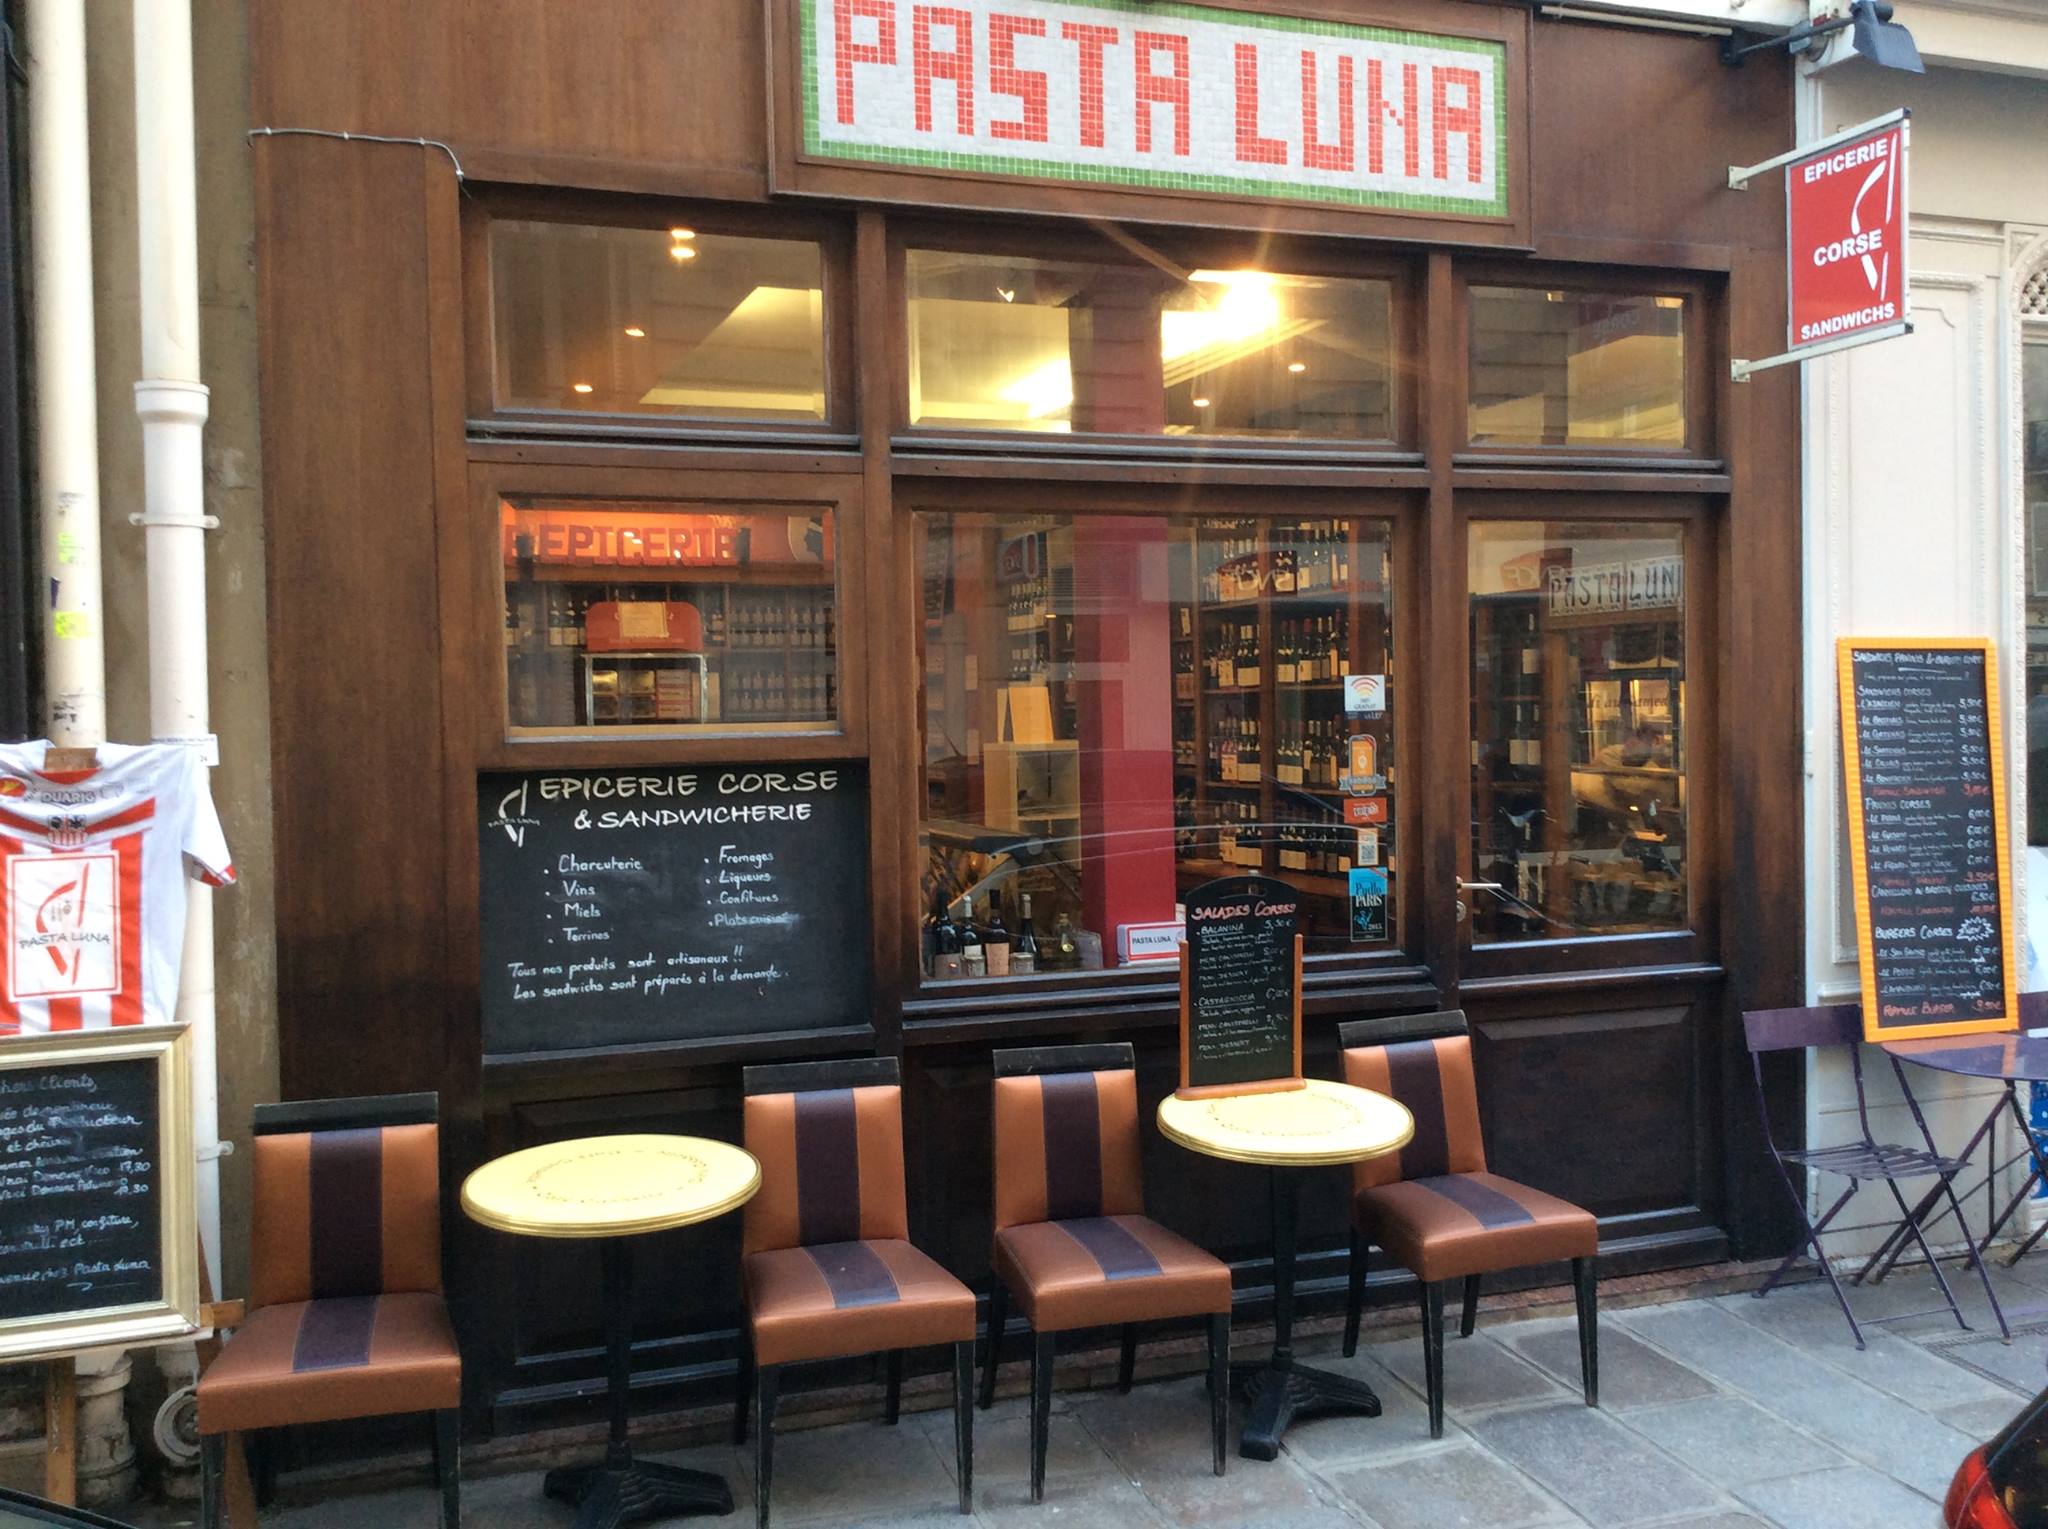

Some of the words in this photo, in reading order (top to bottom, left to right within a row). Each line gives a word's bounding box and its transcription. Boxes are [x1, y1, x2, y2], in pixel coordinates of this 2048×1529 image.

[833, 0, 1191, 156] PASTA
[1235, 43, 1482, 184] LUNA
[1803, 138, 1888, 184] EPICERIE
[1813, 229, 1882, 266] CORSE
[1800, 302, 1895, 340] SANDWICHS
[1551, 572, 1621, 608] PASTA
[540, 774, 698, 800] EPICERIE
[718, 771, 838, 793] CORSE
[574, 809, 592, 830] &
[597, 803, 813, 829] SANDWICHERIE
[558, 854, 643, 873] Charcuterie
[719, 845, 774, 870] Fromages
[719, 870, 772, 886] Liqueurs
[563, 880, 595, 897] Vins
[719, 890, 779, 905] Confitures
[564, 903, 601, 918] Miels
[1355, 894, 1383, 908] PARIS
[714, 913, 746, 927] Plats
[19, 932, 67, 950] PASTA
[71, 931, 110, 944] LUNA
[563, 928, 610, 943] Terrines
[1132, 937, 1152, 945] PASTA
[1153, 935, 1172, 943] LUNA
[1875, 926, 1916, 939] BURGERS
[508, 962, 537, 978] Tous
[543, 965, 562, 975] nos
[569, 958, 616, 981] produits
[627, 951, 656, 969] sont
[667, 953, 729, 967] artisanaux
[512, 984, 537, 1000] Les
[543, 981, 604, 997] sandwichs
[609, 975, 638, 991] sont
[644, 974, 693, 997] préparés
[698, 970, 708, 984] à
[713, 967, 726, 983] la
